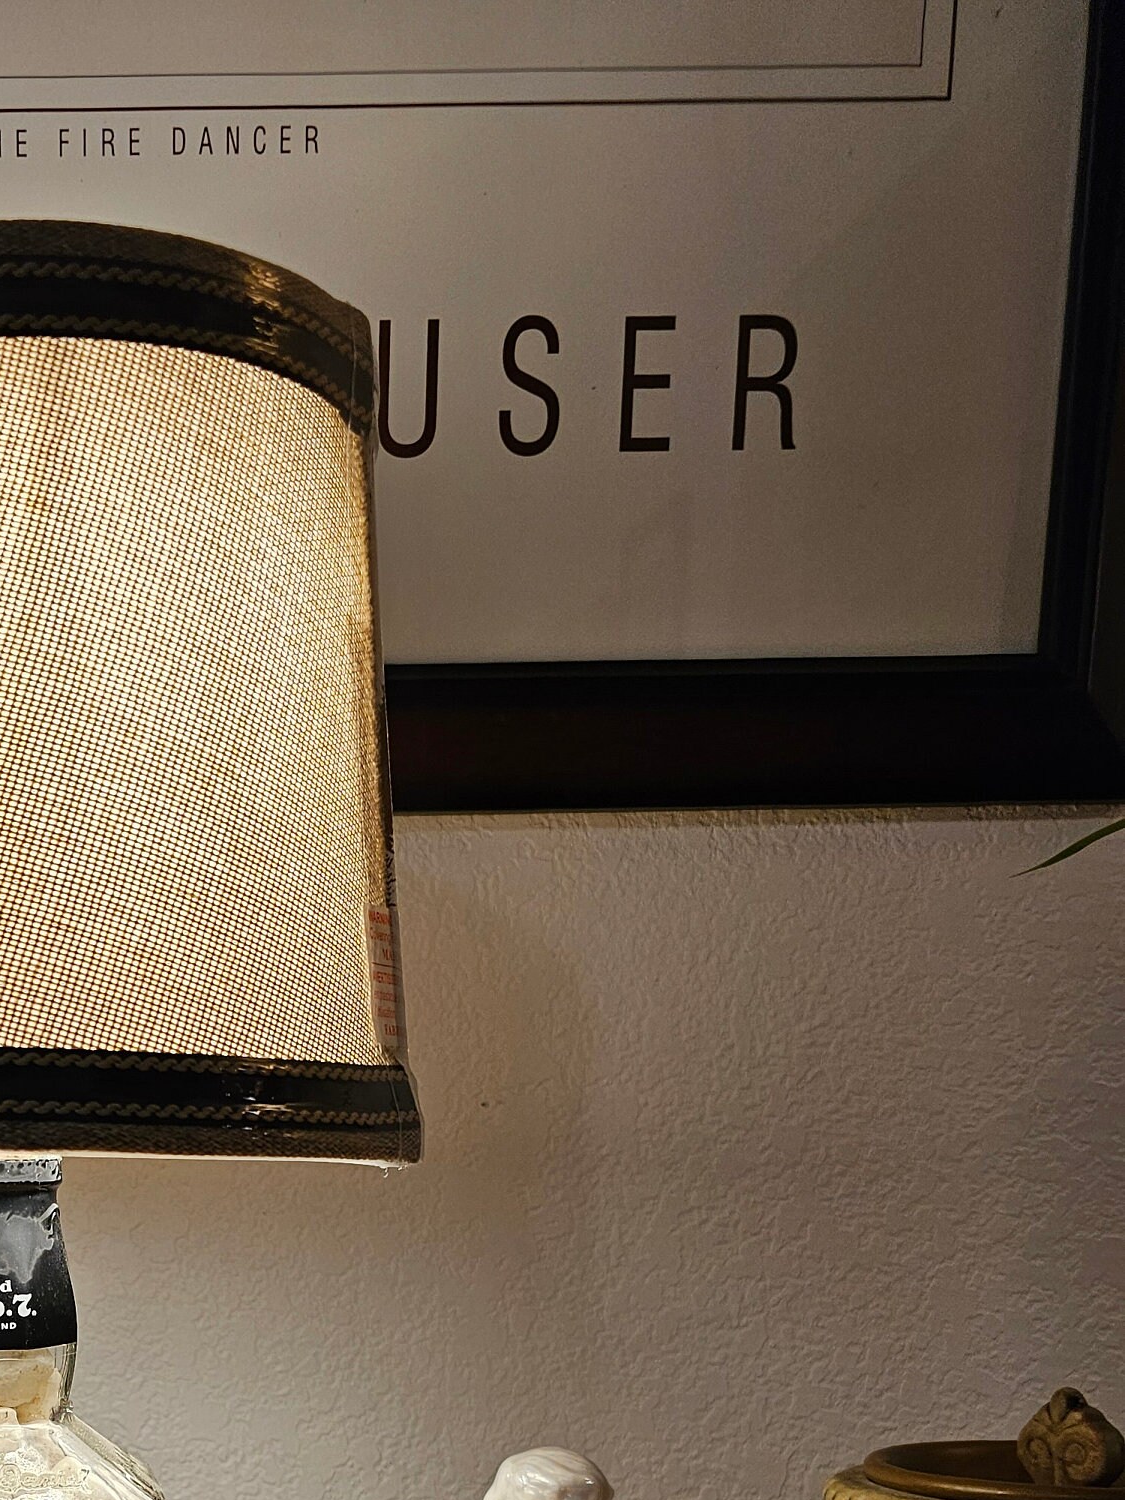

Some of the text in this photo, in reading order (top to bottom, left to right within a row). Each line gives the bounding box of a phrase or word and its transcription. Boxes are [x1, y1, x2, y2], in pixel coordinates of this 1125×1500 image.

[59, 127, 141, 157] FIRE
[172, 125, 320, 156] DANCER
[378, 314, 799, 459] USER
